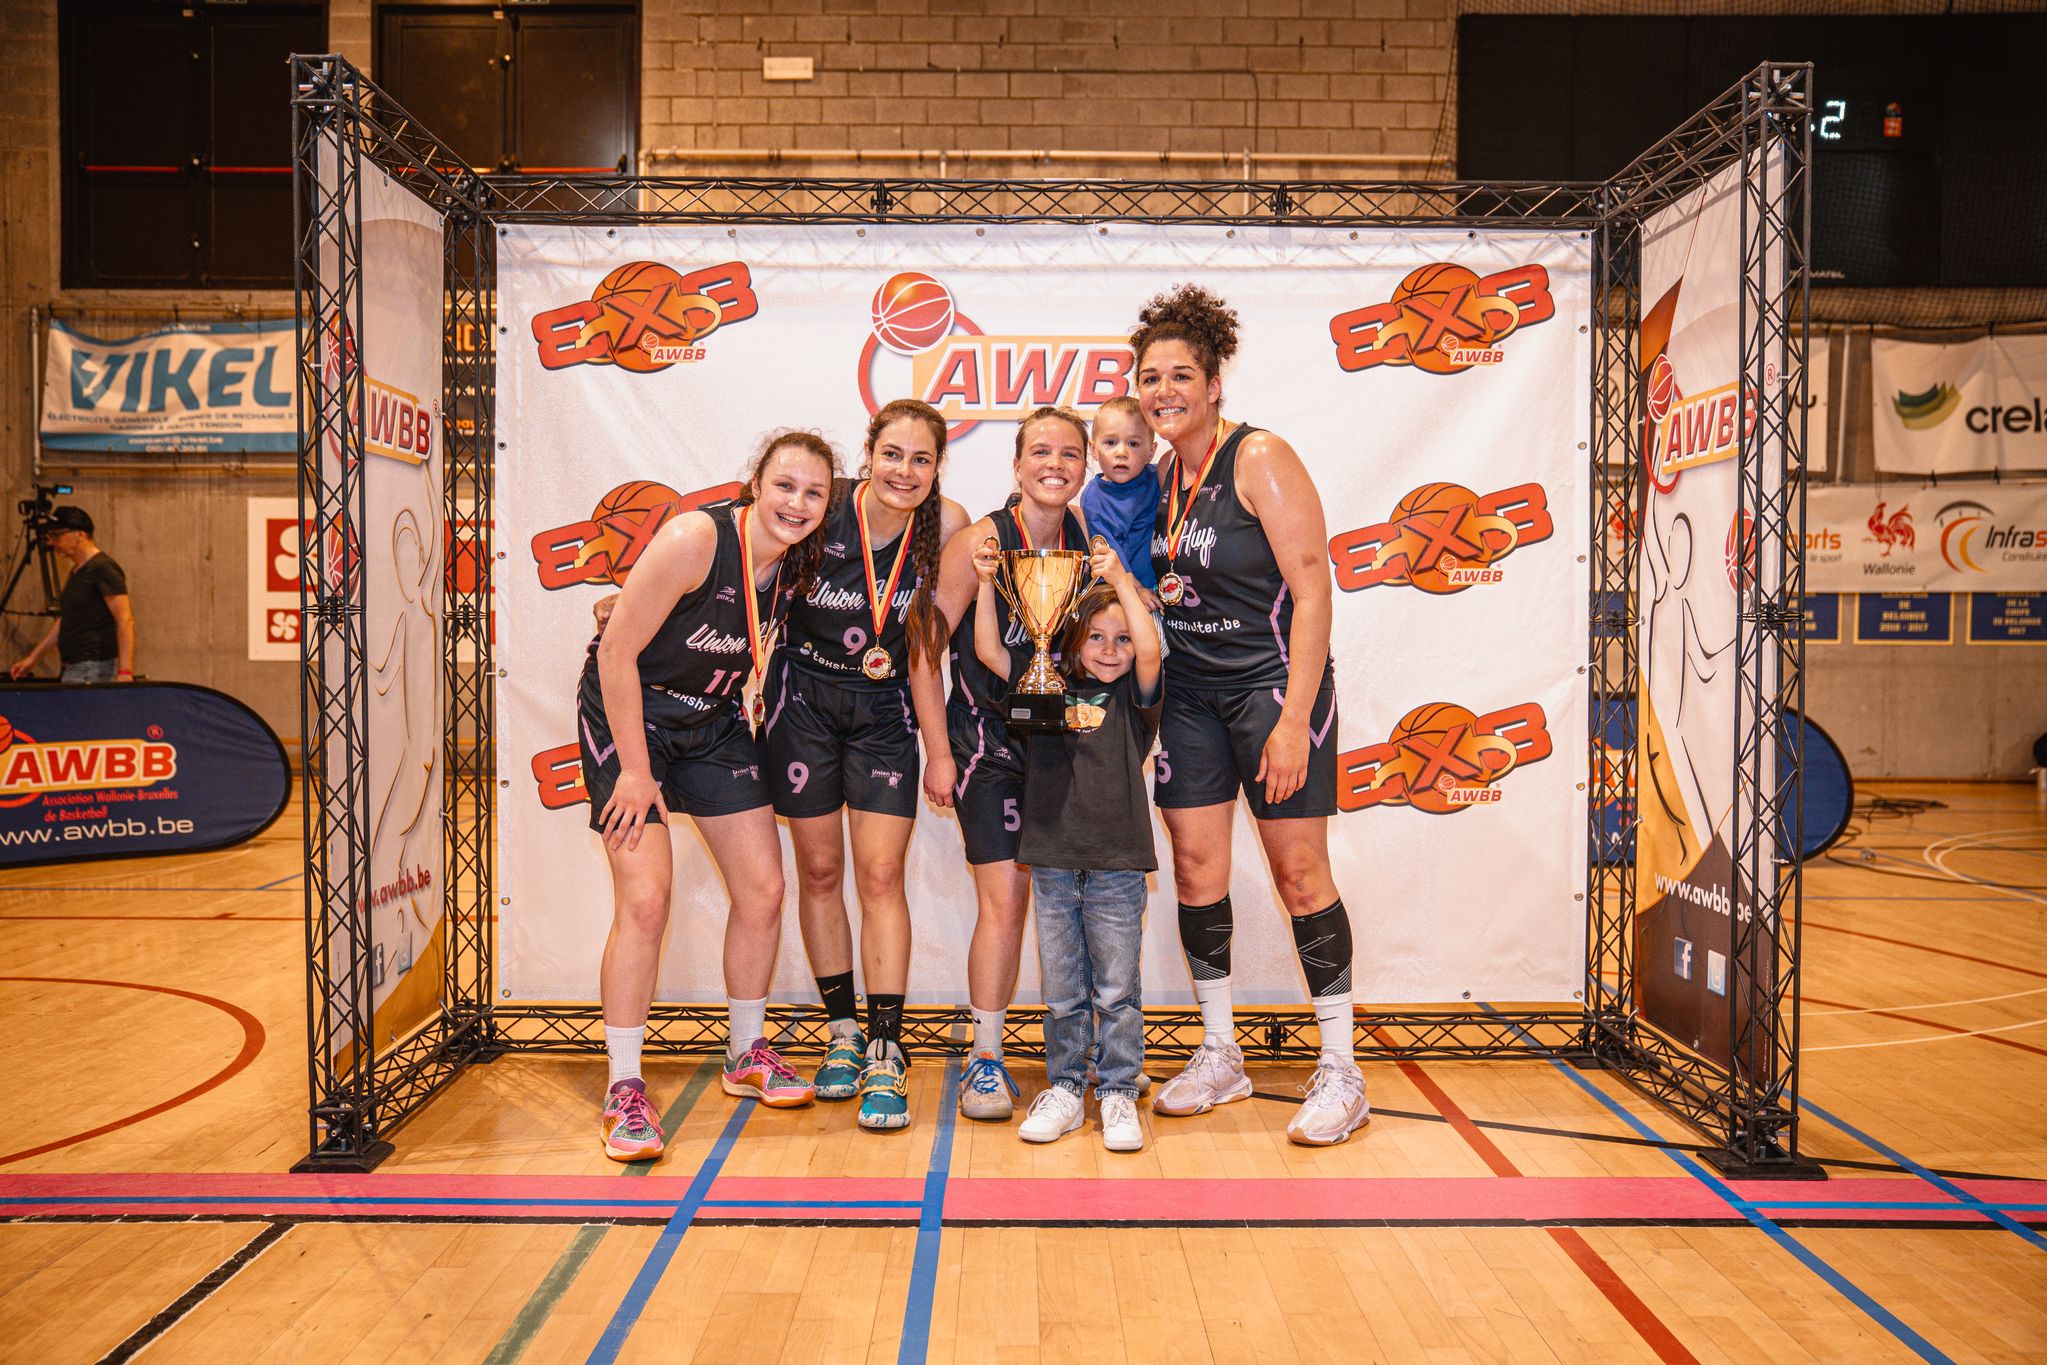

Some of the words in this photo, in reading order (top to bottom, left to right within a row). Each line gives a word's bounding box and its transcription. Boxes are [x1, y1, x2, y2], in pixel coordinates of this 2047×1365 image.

[653, 348, 706, 361] AWBB
[1453, 350, 1504, 363] AWBB
[71, 346, 293, 413] VIKEL
[1965, 397, 2047, 434] crel
[824, 547, 846, 559] DHIKA
[1177, 518, 1217, 569] Huy
[1451, 570, 1503, 583] AWBB
[1863, 562, 1916, 575] Wallonie
[806, 577, 866, 611] Union
[686, 624, 747, 654] Union
[843, 627, 868, 656] 9
[3, 743, 177, 788] AWBB
[787, 761, 809, 794] 9
[42, 794, 94, 806] Association
[1450, 789, 1503, 802] AWBB
[44, 809, 57, 822] de
[59, 804, 108, 821] Basketball
[1003, 798, 1021, 832] 5
